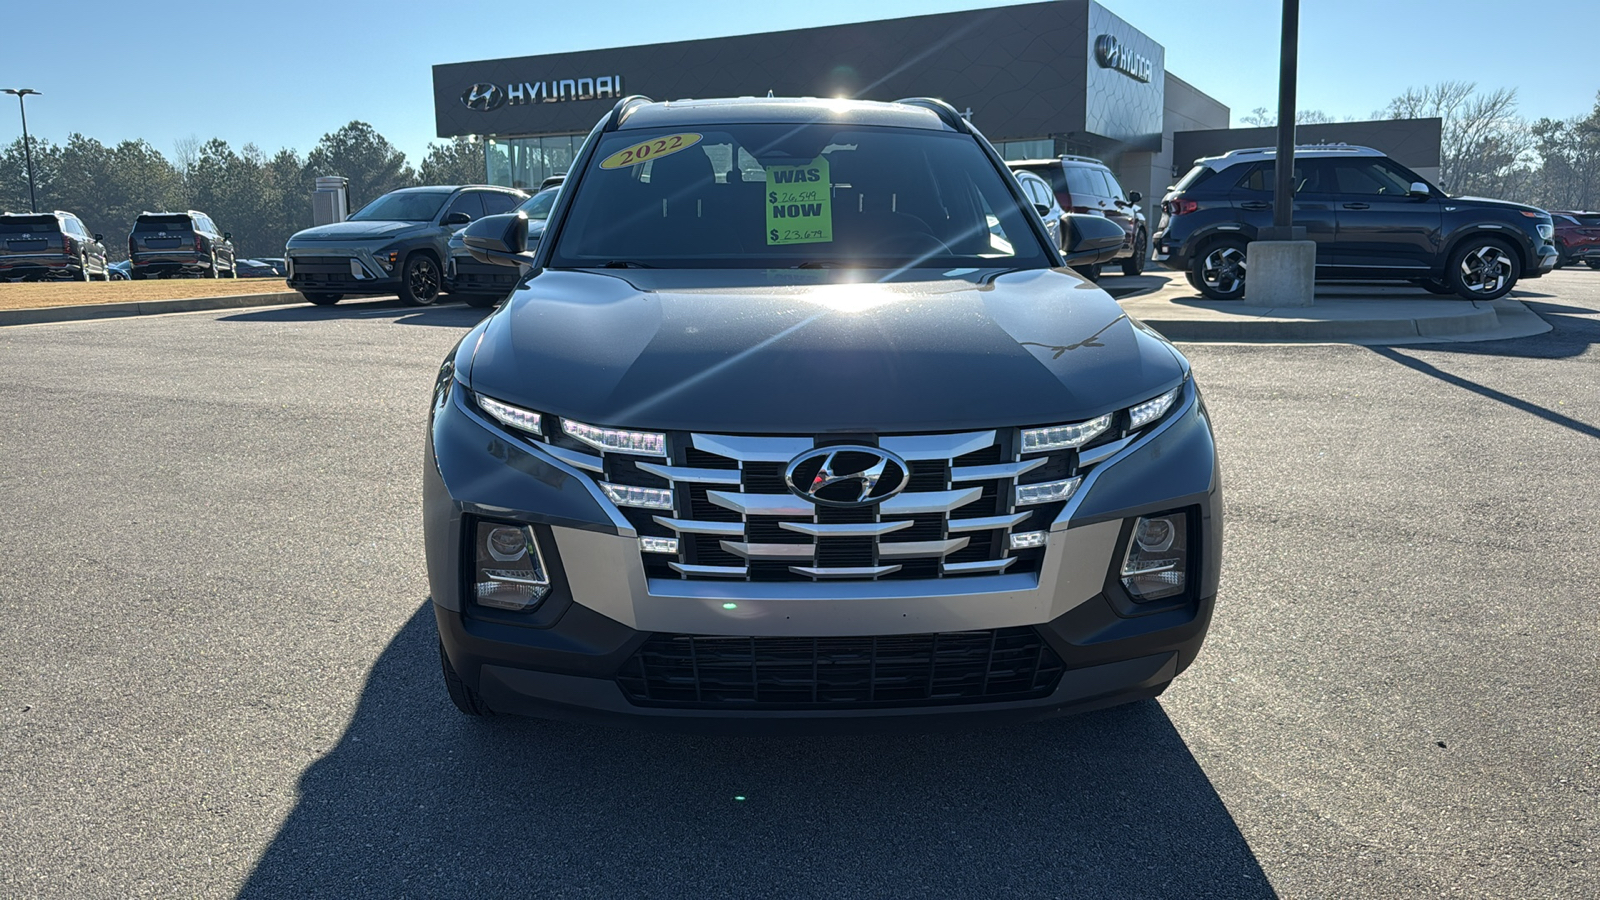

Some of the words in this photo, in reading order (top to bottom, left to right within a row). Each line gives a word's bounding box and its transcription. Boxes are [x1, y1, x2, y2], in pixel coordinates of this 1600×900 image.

[1119, 45, 1152, 83] HYUNDAI
[507, 75, 622, 105] HYUNDAI
[619, 135, 684, 166] 2022
[773, 168, 821, 184] WAS
[772, 203, 822, 218] NOW
